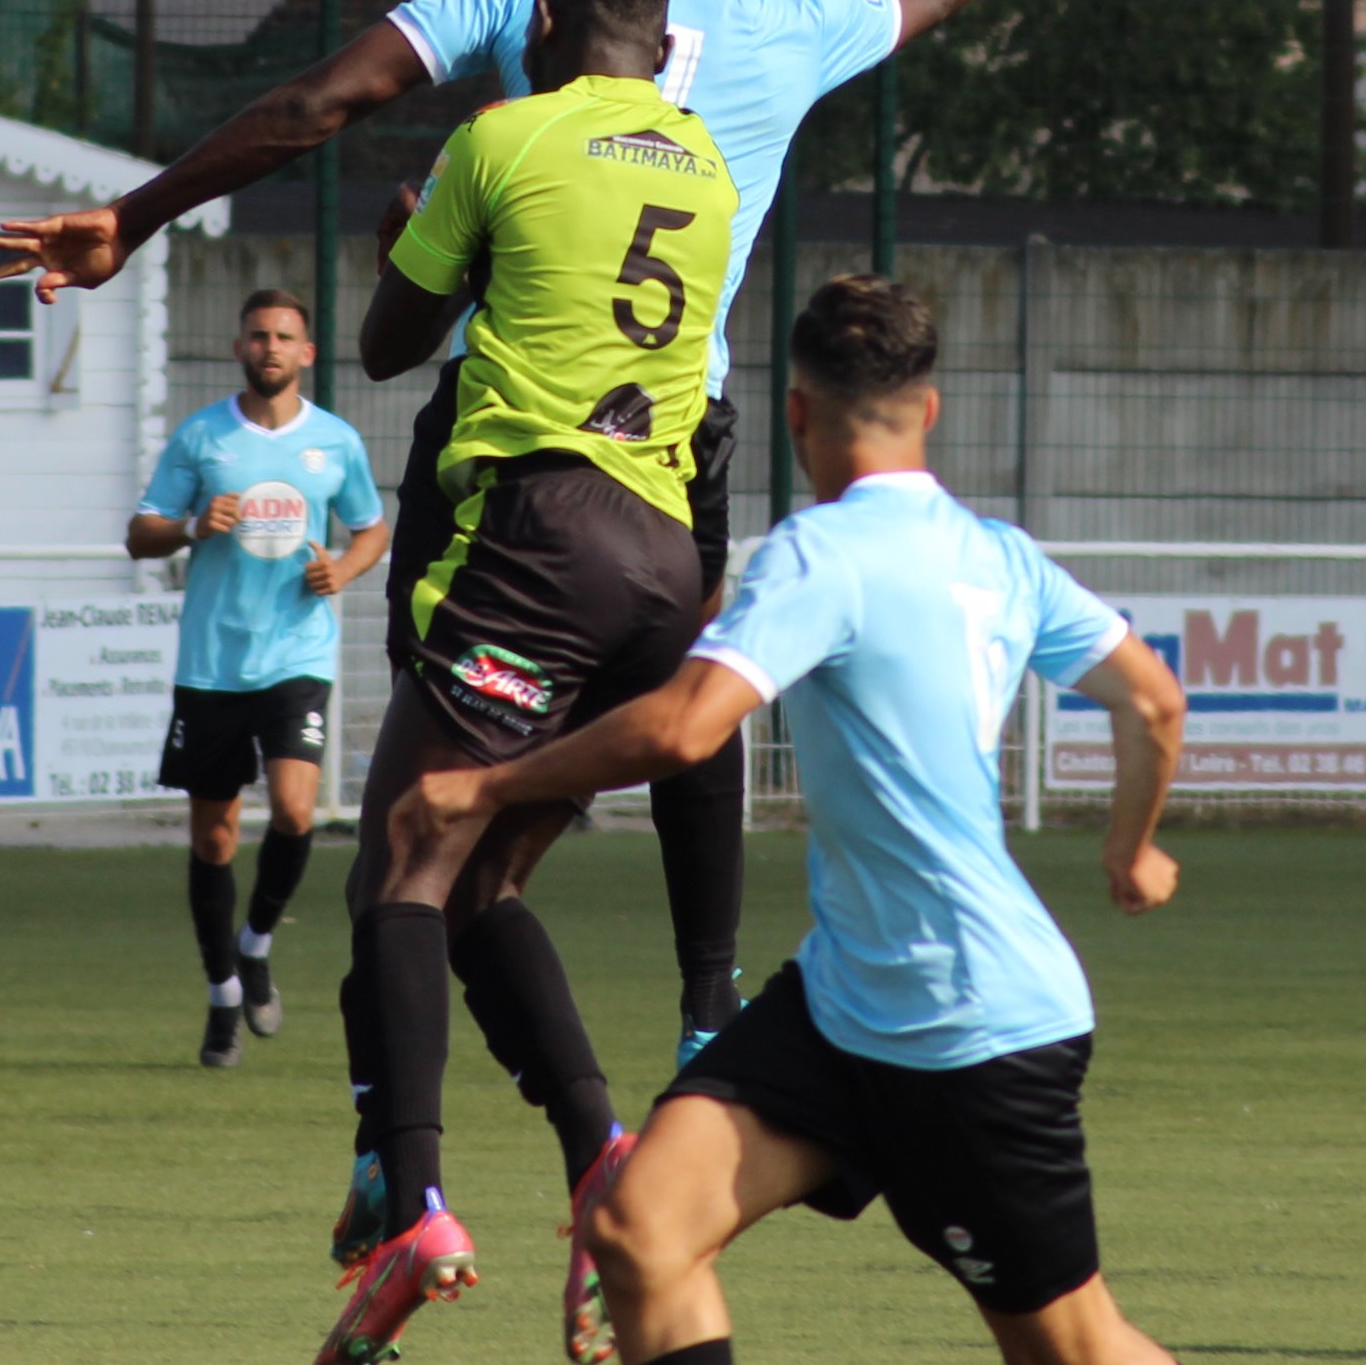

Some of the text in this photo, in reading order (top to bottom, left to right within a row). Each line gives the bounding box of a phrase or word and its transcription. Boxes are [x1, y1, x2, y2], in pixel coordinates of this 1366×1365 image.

[588, 138, 697, 175] BATIMAYA
[611, 202, 697, 351] 5
[240, 497, 304, 520] ADN
[239, 519, 304, 534] SPORT
[137, 602, 183, 627] RENA
